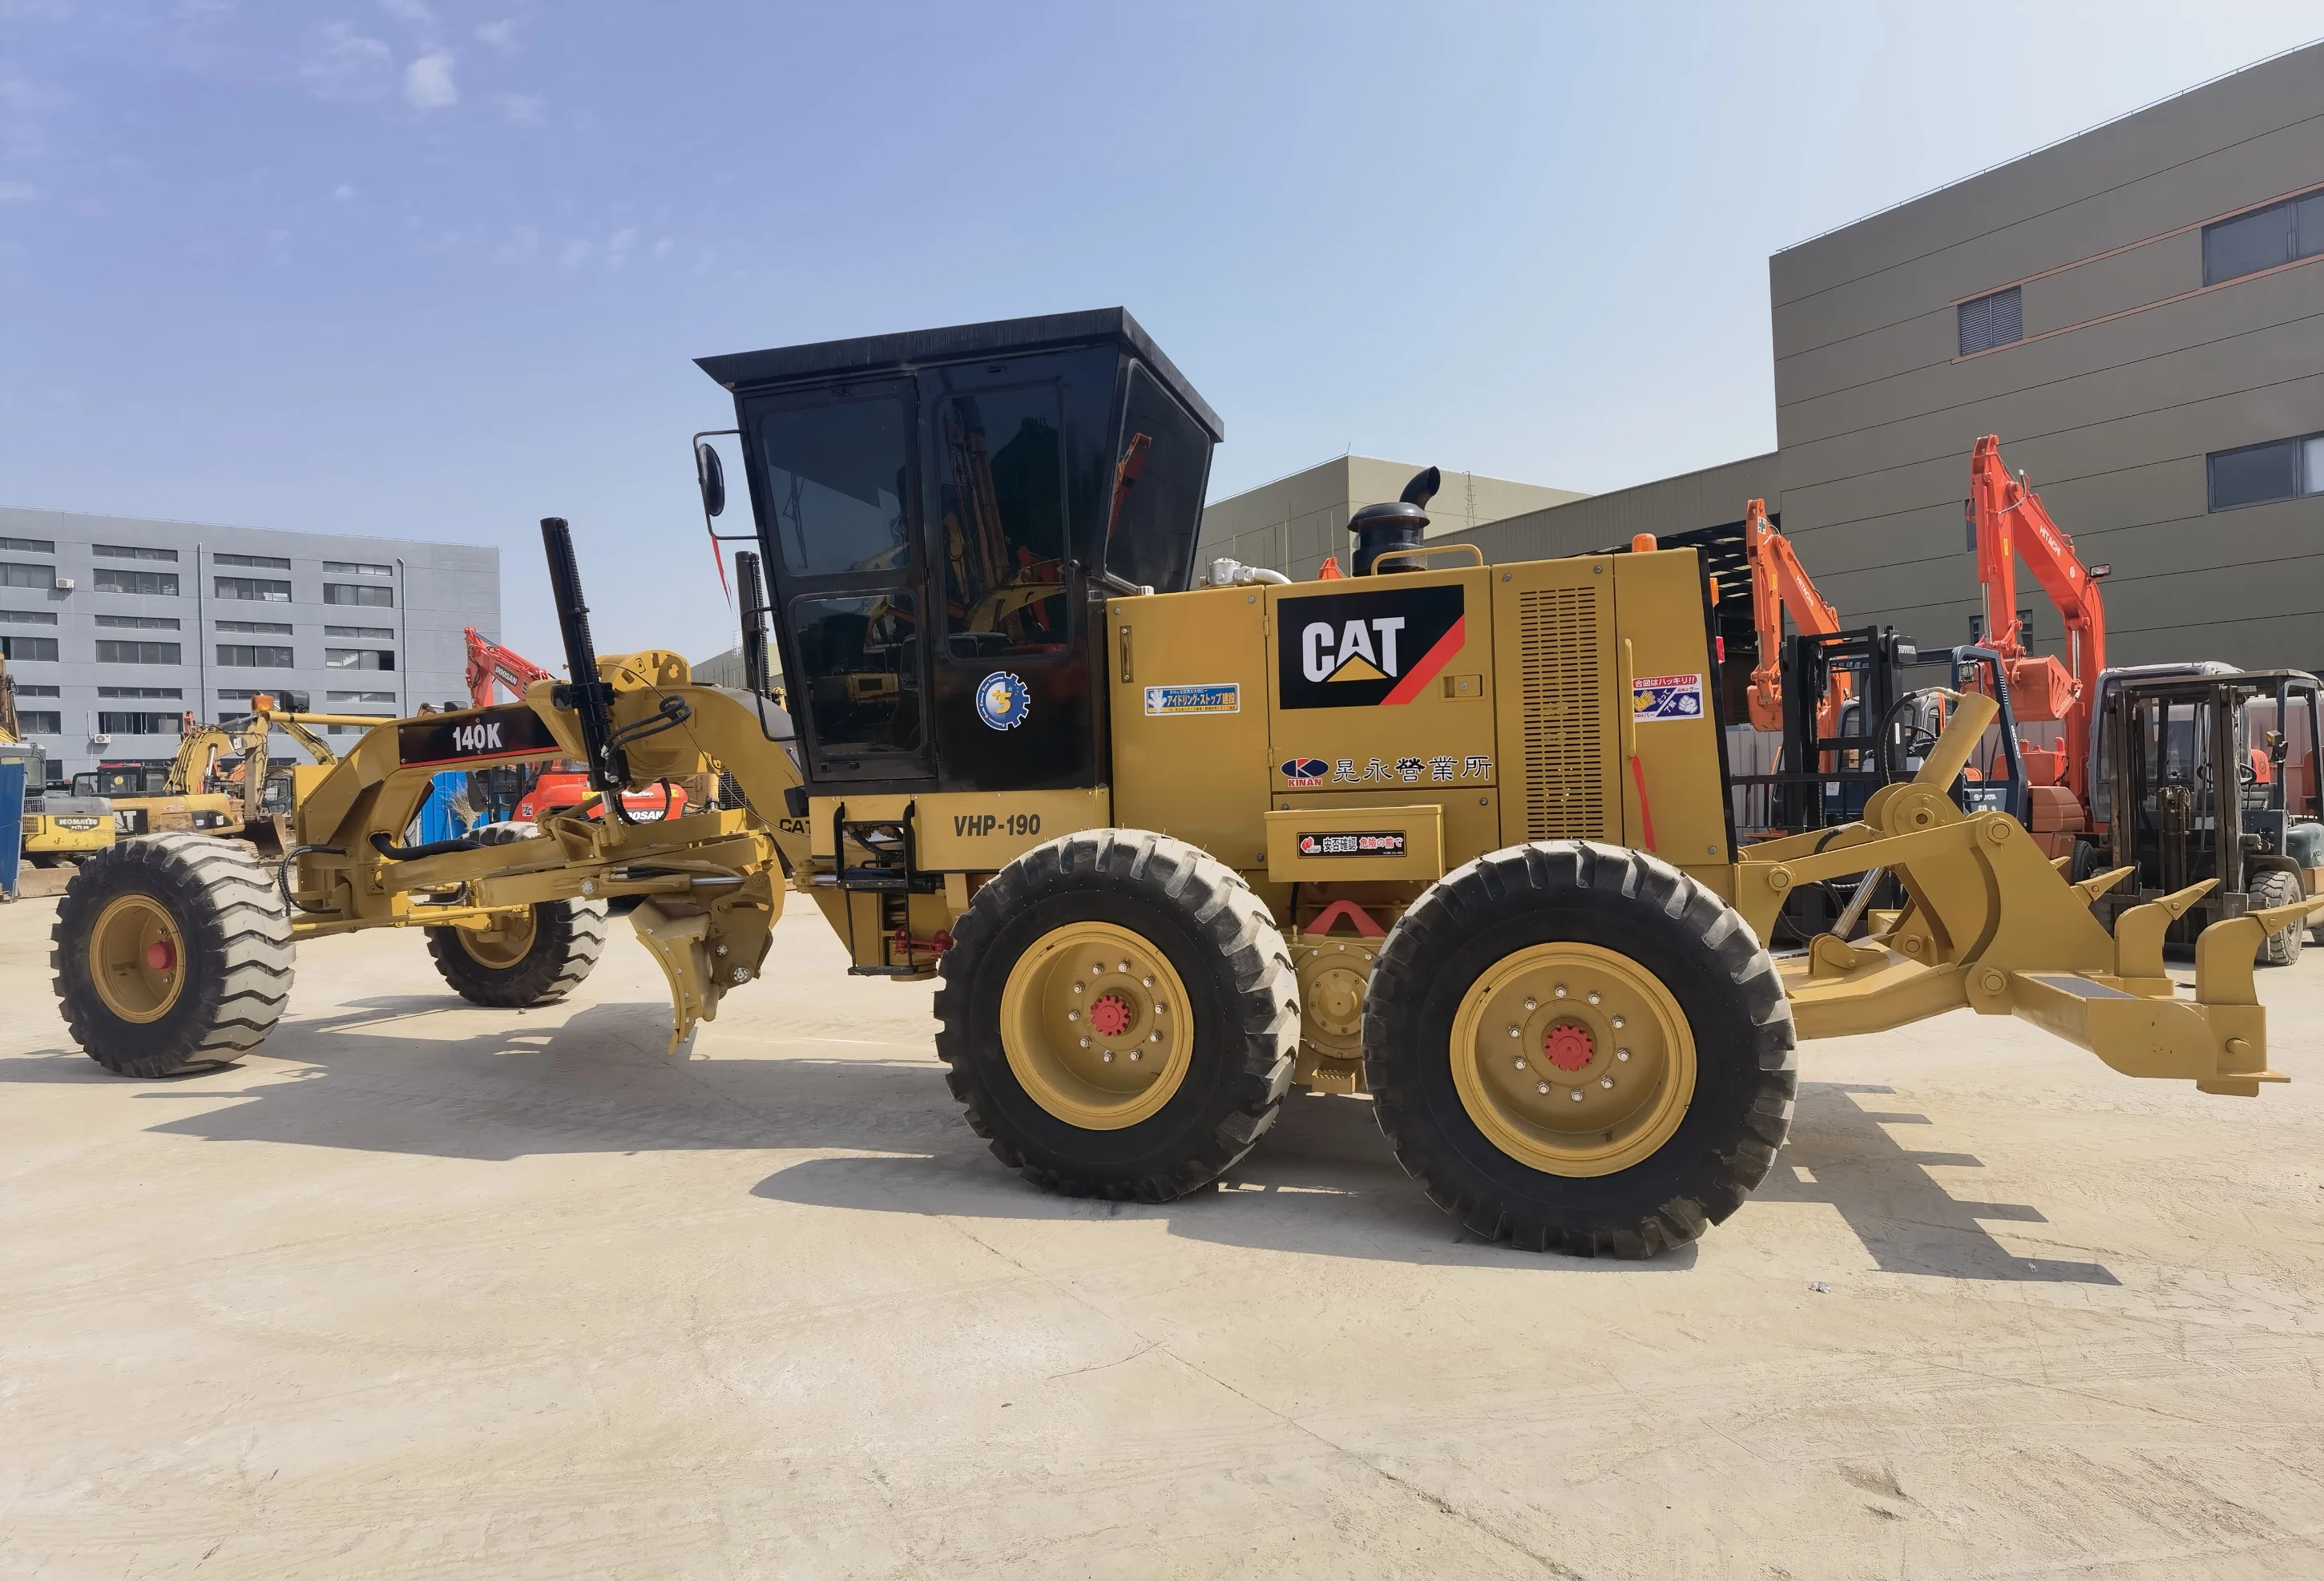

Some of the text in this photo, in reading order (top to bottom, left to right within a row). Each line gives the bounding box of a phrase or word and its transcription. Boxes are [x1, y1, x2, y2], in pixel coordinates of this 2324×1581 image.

[2040, 525, 2061, 557] HITACHI
[1796, 575, 1814, 607] HITACHI
[1302, 616, 1405, 682] CAT
[1897, 644, 1916, 655] TOYOTA
[494, 665, 518, 686] DOOSAN
[452, 723, 502, 751] 140K
[1288, 778, 1322, 787] KINAN
[59, 817, 98, 825] KOMATSU
[113, 811, 137, 833] AT
[627, 811, 664, 821] OSAN
[954, 813, 1041, 837] VHP-190
